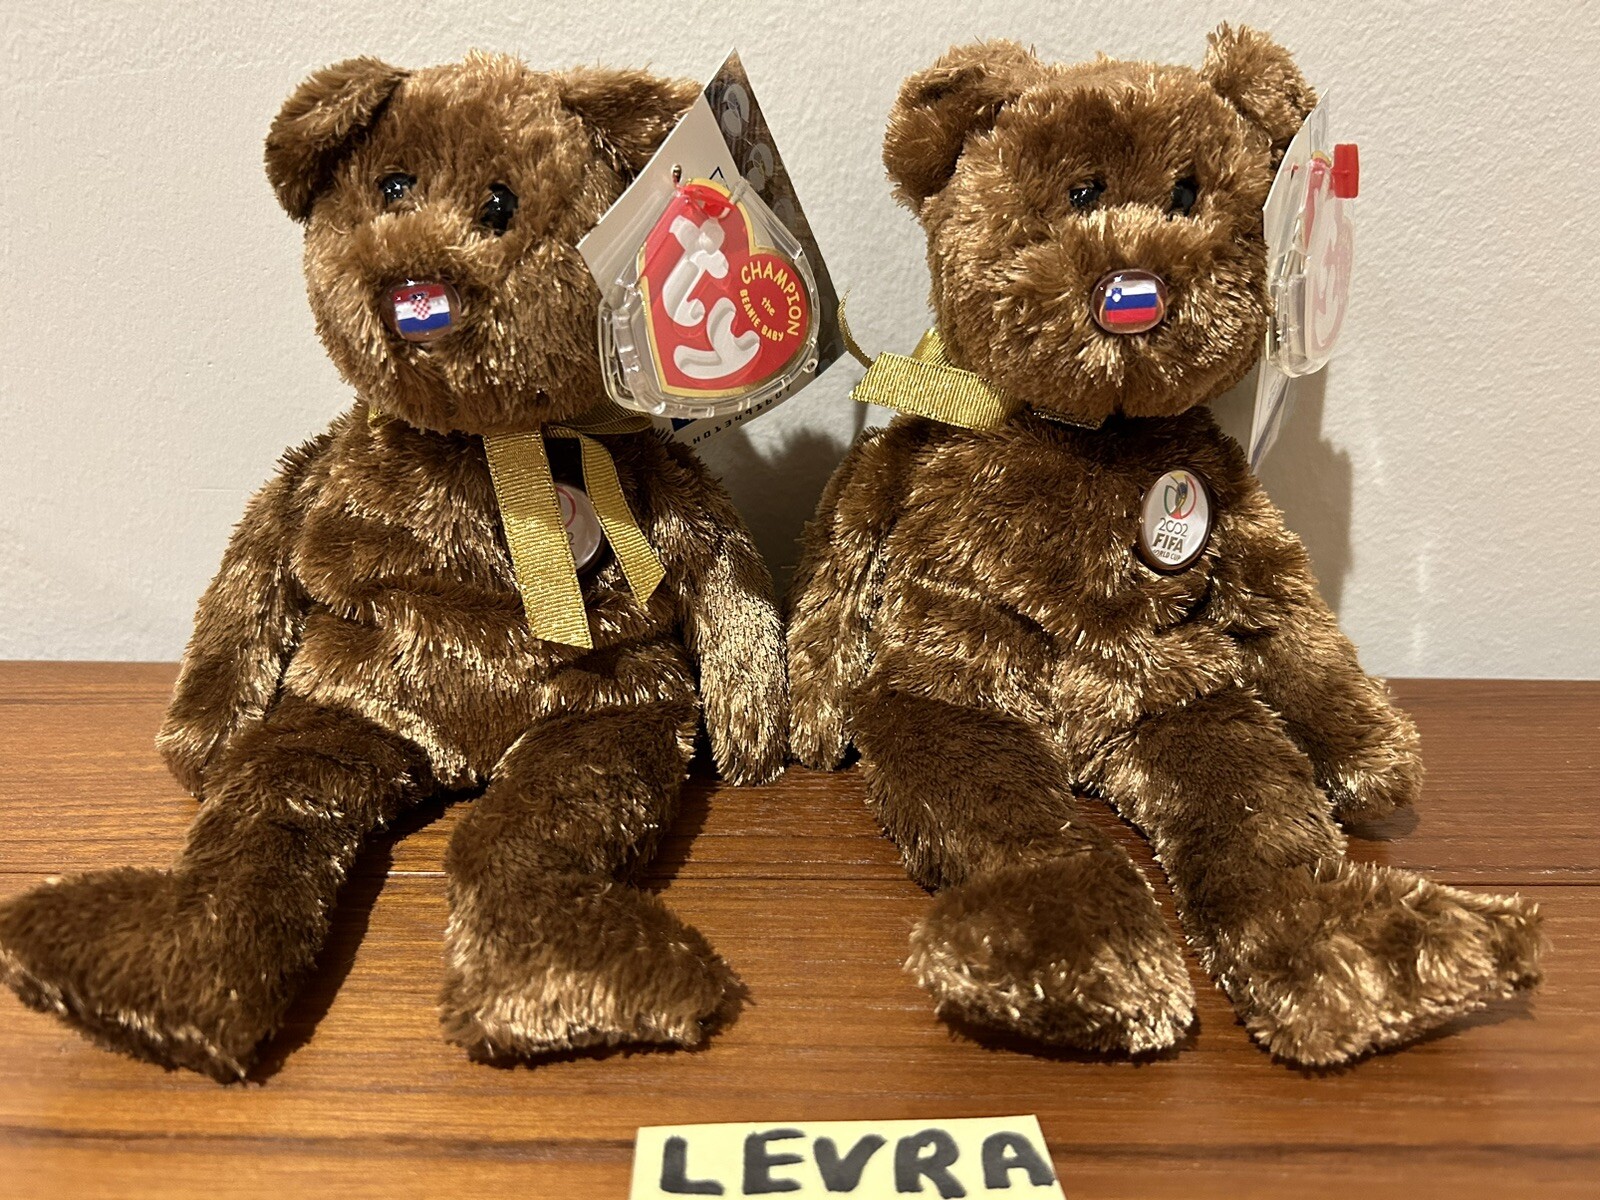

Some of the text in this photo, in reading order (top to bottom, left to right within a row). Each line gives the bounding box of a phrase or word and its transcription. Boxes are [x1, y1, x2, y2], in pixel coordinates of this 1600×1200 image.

[662, 215, 761, 380] ty
[740, 289, 784, 342] BEANIE BABY
[741, 260, 802, 336] CHAMPION
[761, 297, 776, 316] the
[1152, 532, 1183, 553] FIFA
[1158, 517, 1188, 537] 2002
[659, 1127, 1056, 1199] LEVRA
